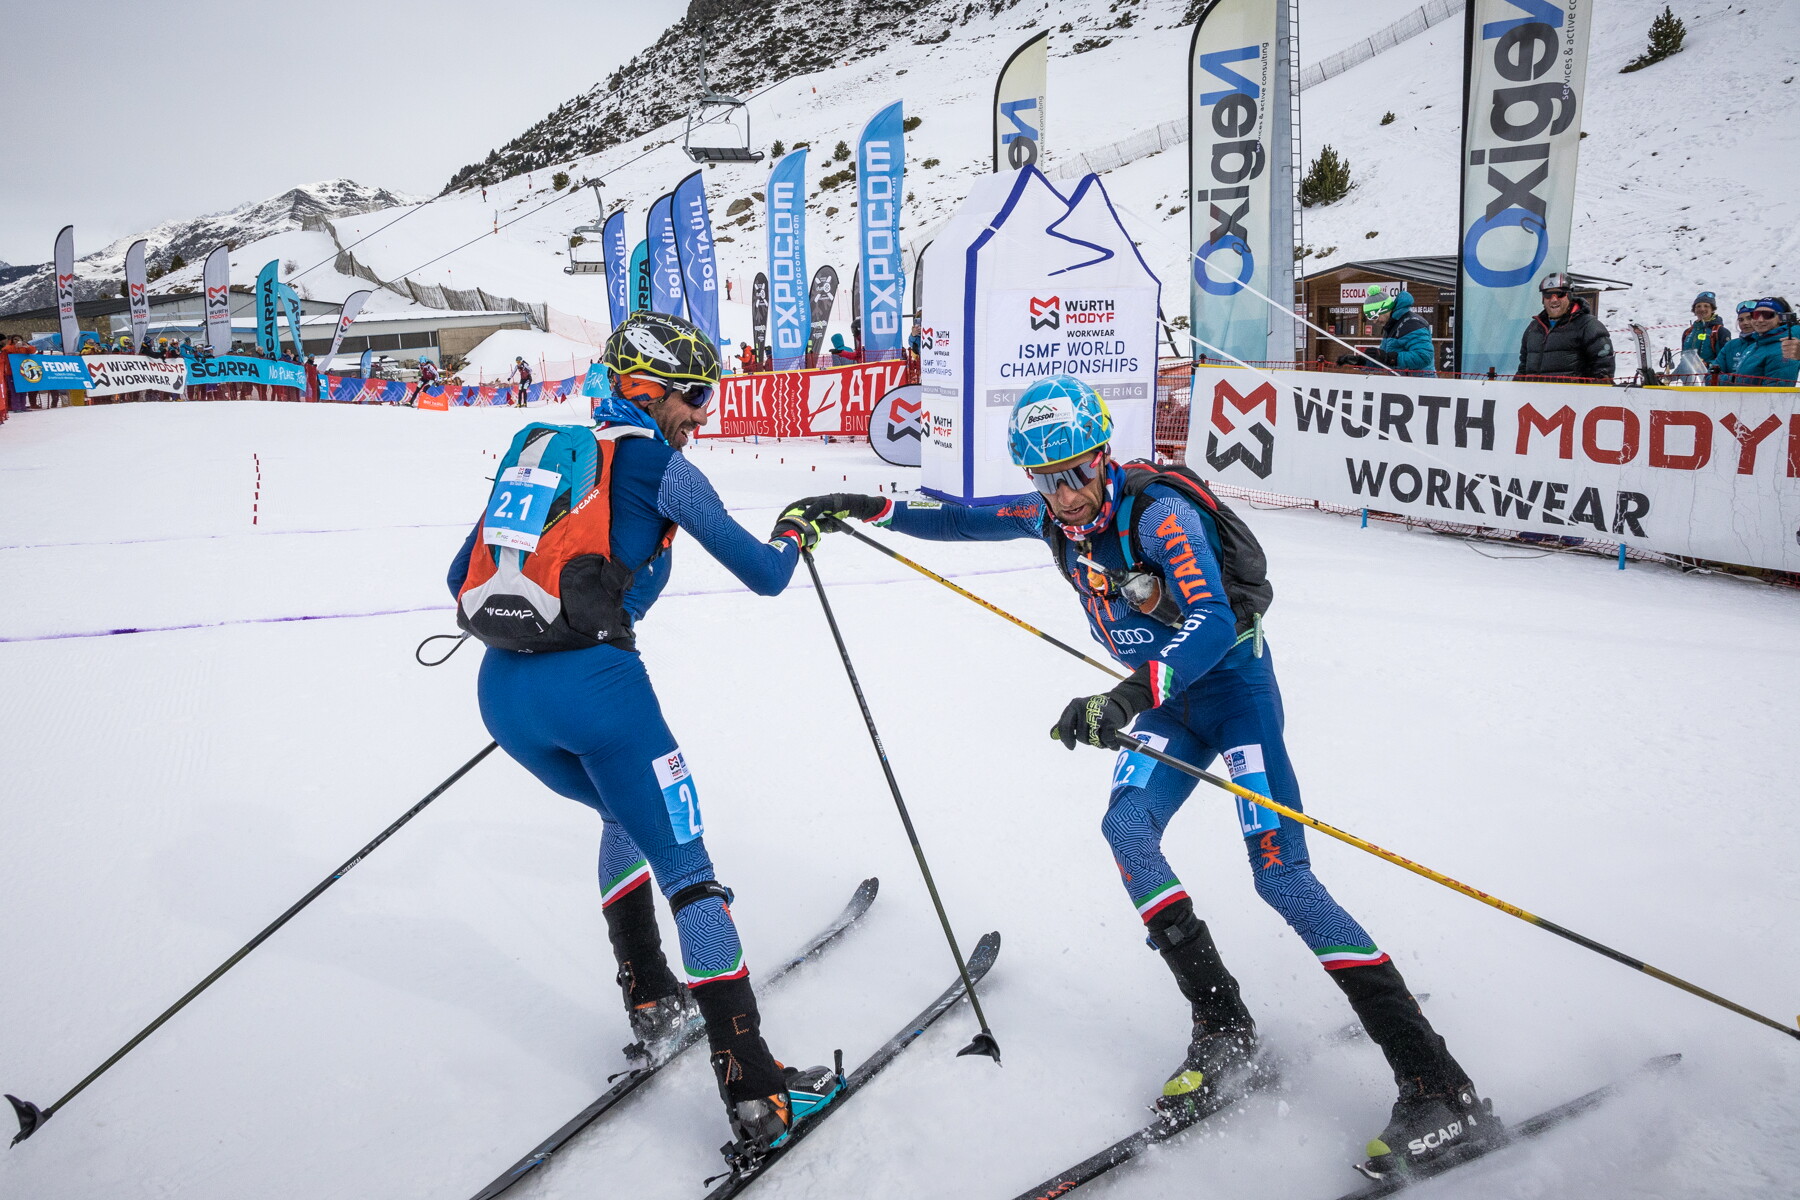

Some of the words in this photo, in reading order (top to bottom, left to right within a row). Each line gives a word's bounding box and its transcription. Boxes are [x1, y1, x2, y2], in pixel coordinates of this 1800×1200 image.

[1565, 13, 1576, 41] active
[1563, 43, 1573, 56] &
[690, 196, 710, 254] TAÜLL
[866, 141, 898, 335] expocom
[698, 257, 716, 291] BOÍ
[774, 181, 802, 350] expocom
[792, 213, 806, 322] www.expocomsa.com
[664, 268, 681, 298] BOÍ
[1342, 288, 1366, 298] ESCOLA
[1064, 300, 1114, 312] WÜRTH
[1066, 313, 1114, 324] MODYF
[1066, 330, 1114, 338] WORKWEAR
[1018, 343, 1060, 359] ISMF
[1067, 340, 1126, 356] WORLD
[42, 362, 81, 373] FEDME
[107, 362, 150, 372] WÜRTH
[191, 362, 260, 378] SCARPA
[1000, 358, 1138, 378] CHAMPIONSHIPS
[112, 374, 170, 386] WORKWEAR
[724, 378, 767, 418] ATK
[993, 393, 1016, 404] SKI
[724, 420, 770, 435] BINDINGS
[1028, 412, 1054, 424] Besson
[1293, 386, 1496, 450] WÜRTH
[1516, 402, 1800, 478] MODY
[494, 491, 534, 520] 2.1
[579, 488, 600, 510] CAMP
[1346, 458, 1650, 538] WORKWEAR
[1156, 514, 1212, 604] ITALIA
[494, 609, 532, 619] CAMP
[1160, 614, 1206, 658] Audi
